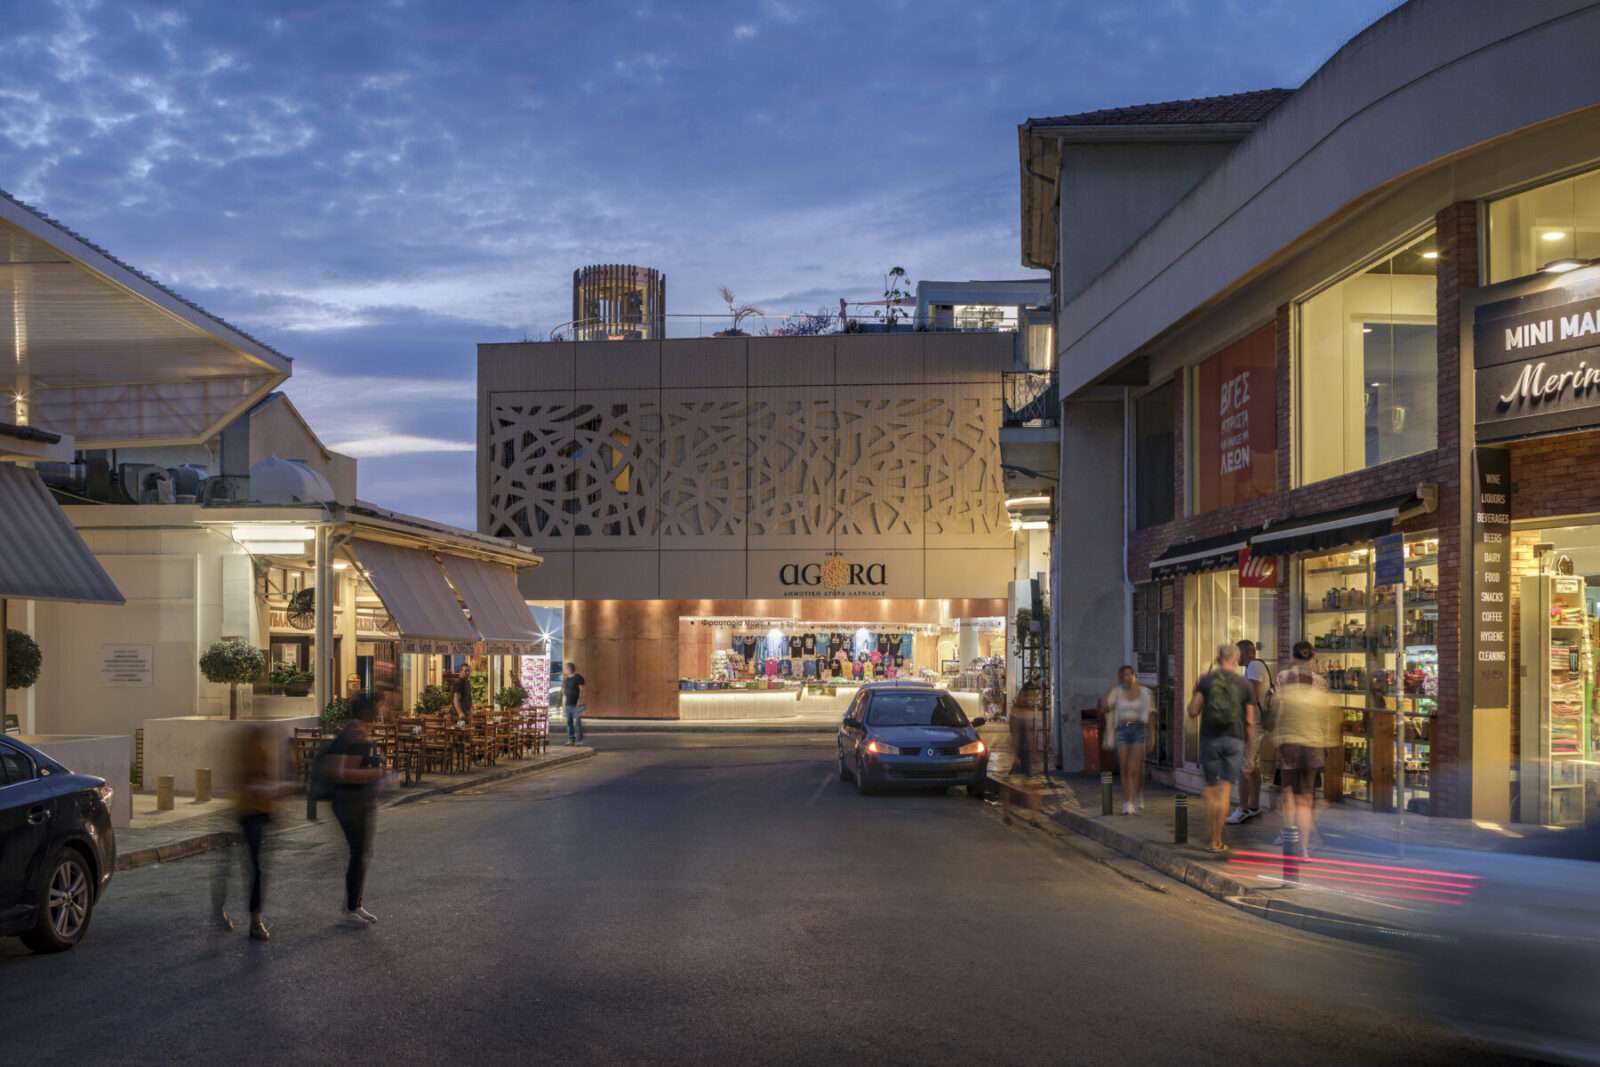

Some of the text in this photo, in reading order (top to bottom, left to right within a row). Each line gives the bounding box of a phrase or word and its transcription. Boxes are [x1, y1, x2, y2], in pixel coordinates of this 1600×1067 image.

[1505, 319, 1553, 351] MINI
[1485, 474, 1501, 485] WINE
[1481, 493, 1505, 505] LIQUORS
[1476, 512, 1509, 524] BEVERAGES
[1483, 533, 1502, 544] BEERS
[1484, 552, 1501, 563] DAIRY
[1242, 555, 1274, 583] illy
[1484, 572, 1500, 583] FOOD
[1481, 591, 1504, 602] SNACKS
[1481, 611, 1503, 622] COFFEE
[1480, 631, 1504, 642] HYGIENE
[1478, 650, 1506, 661] CLEANING
